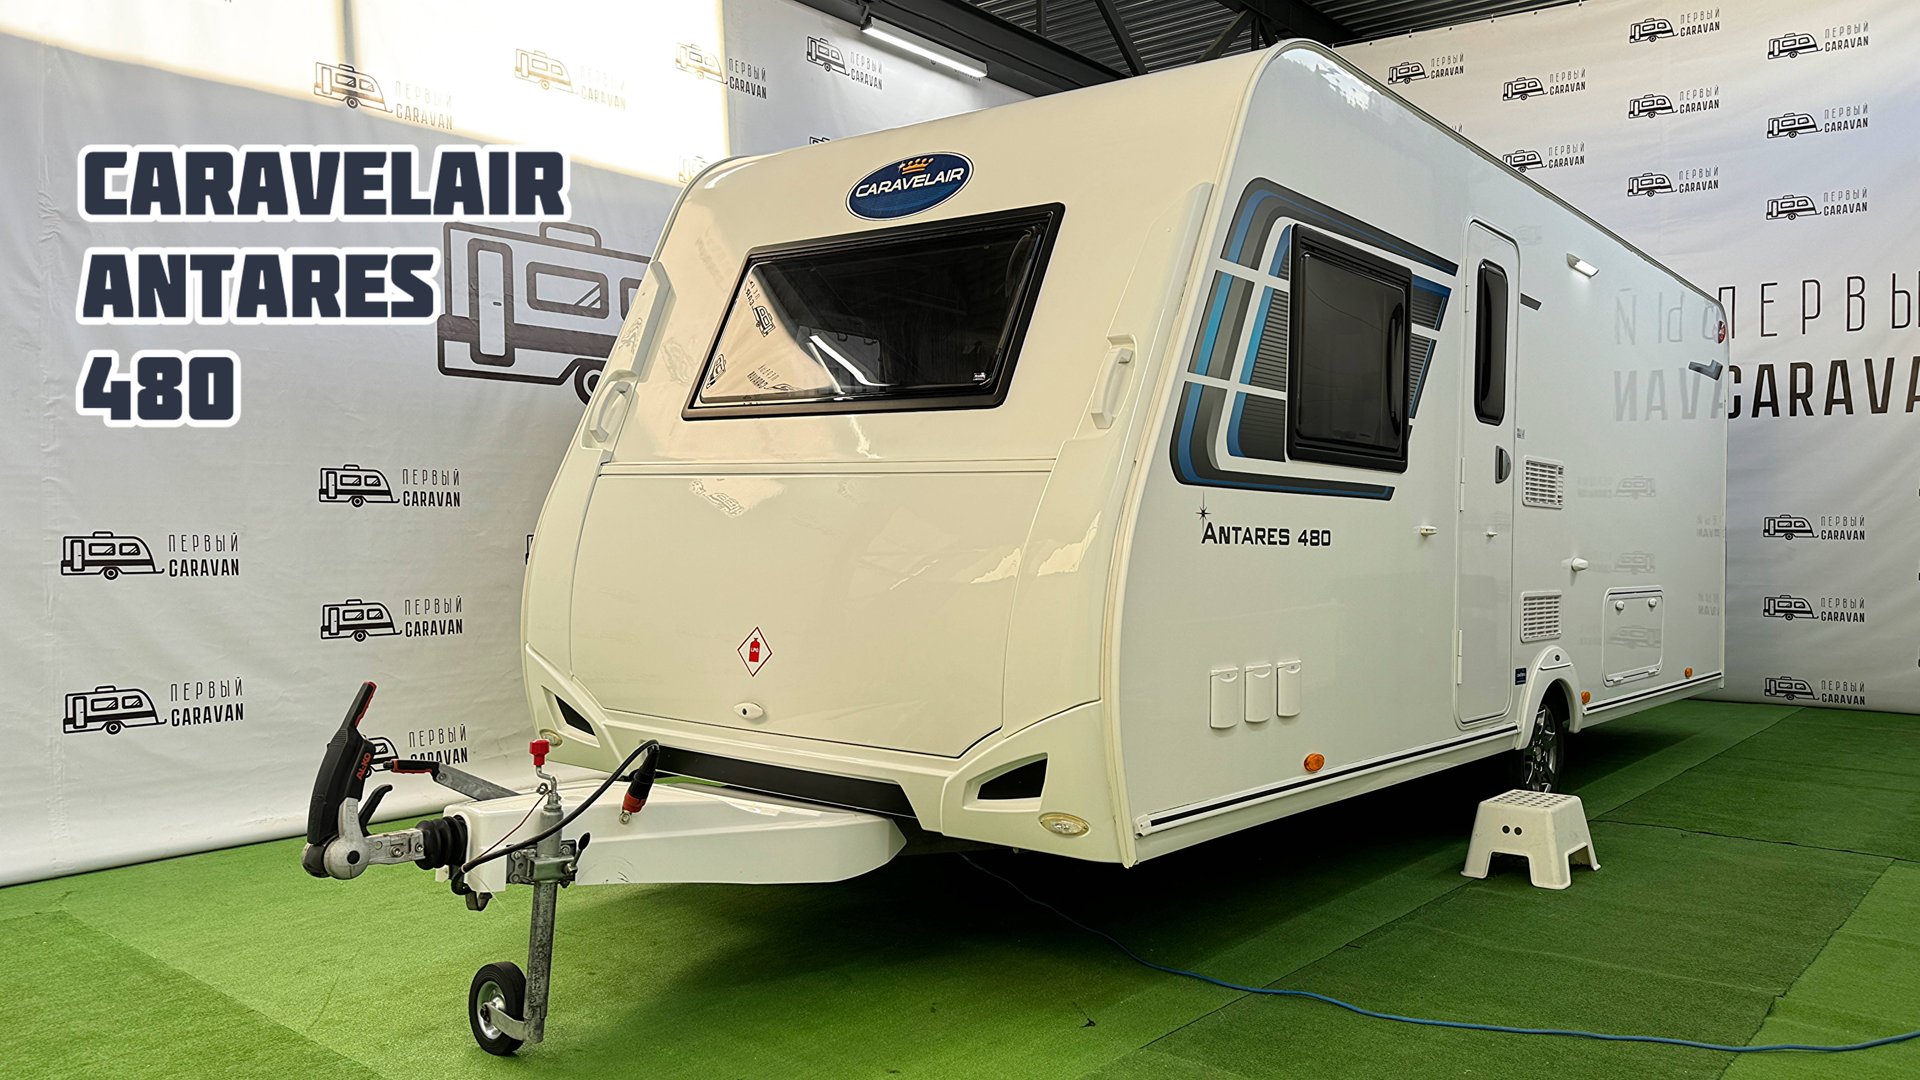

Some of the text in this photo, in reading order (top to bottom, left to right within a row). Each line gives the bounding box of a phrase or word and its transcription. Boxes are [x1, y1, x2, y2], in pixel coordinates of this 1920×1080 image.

[1680, 8, 1720, 24] ПЕРВЫЙ
[1680, 21, 1720, 37] CARAVAN
[1825, 20, 1868, 39] ПЕРВЫЙ
[1825, 36, 1869, 52] CARAVAN
[1430, 52, 1464, 67] ПЕРВЫЙ
[850, 68, 883, 91] CARAVAN
[1430, 65, 1464, 79] CARAVAN
[1549, 68, 1586, 83] ПЕРВЫЙ
[728, 76, 767, 100] CARAVAN
[1549, 81, 1586, 95] CARAVAN
[1679, 84, 1719, 101] ПЕРВЫЙ
[1679, 99, 1719, 114] CARAVAN
[1824, 102, 1868, 120] ПЕРВЫЙ
[395, 103, 453, 130] CARAVAN
[1824, 117, 1869, 133] CARAVAN
[1548, 141, 1585, 157] ПЕРВЫЙ
[1548, 155, 1585, 168] CARAVAN
[1678, 165, 1719, 180] ПЕРВЫЙ
[856, 168, 964, 198] CARAVELAIR
[1678, 179, 1719, 193] CARAVAN
[1823, 187, 1868, 202] ПЕРВЫЙ
[1823, 202, 1868, 216] CARAVAN
[403, 469, 460, 486] ПЕРВЫЙ
[403, 491, 461, 507] CARAVAN
[1821, 515, 1865, 527] ПЕРВЫЙ
[169, 532, 239, 552] ПЕРВЫЙ
[1201, 522, 1331, 547] ANTARES 480
[1821, 530, 1865, 541] CARAVAN
[169, 558, 240, 577] CARAVAN
[405, 595, 462, 615] ПЕРВЫЙ
[1821, 597, 1865, 609] ПЕРВЫЙ
[1821, 611, 1865, 623] CARAVAN
[405, 618, 463, 637] CARAVAN
[171, 676, 243, 702] ПЕРВЫЙ
[1821, 680, 1865, 692] ПЕРВЫЙ
[1822, 693, 1866, 706] CARAVAN
[171, 703, 244, 727] CARAVAN
[408, 723, 467, 748] ПЕРВЫЙ
